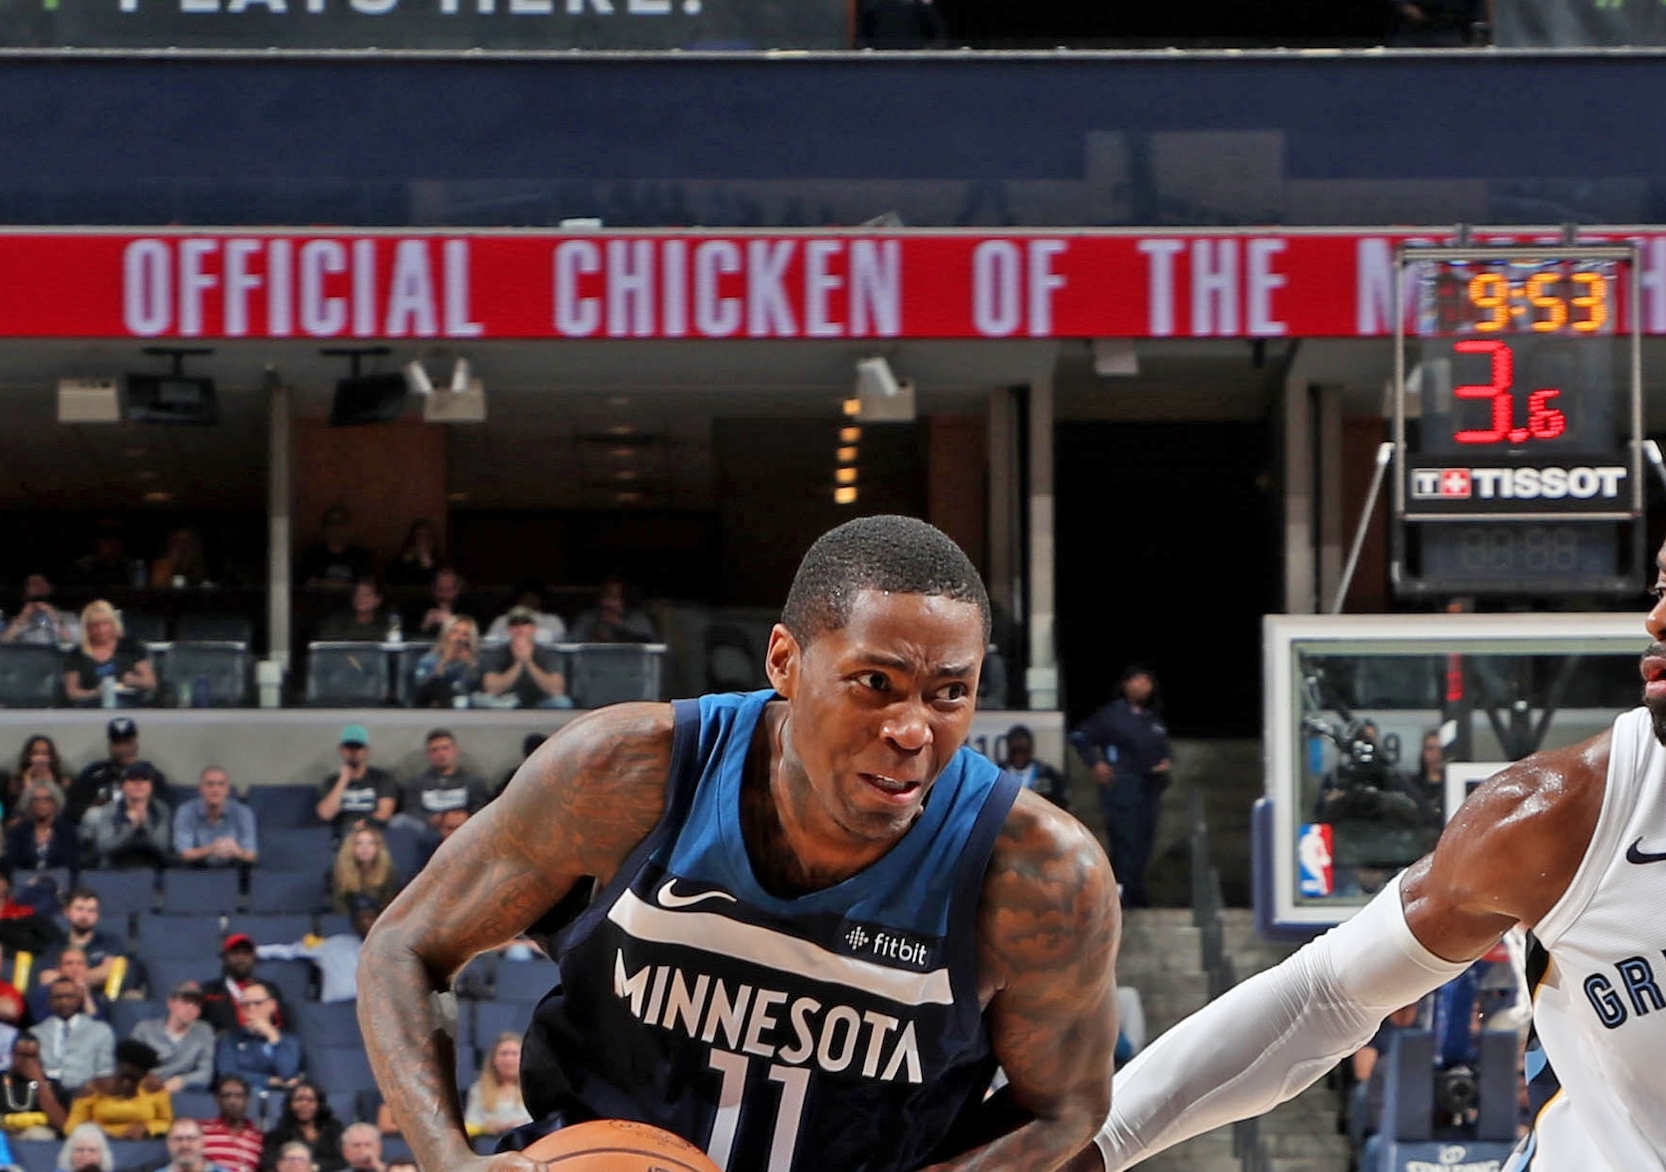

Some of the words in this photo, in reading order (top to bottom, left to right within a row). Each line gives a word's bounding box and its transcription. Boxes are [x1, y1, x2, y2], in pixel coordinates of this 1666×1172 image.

[125, 238, 483, 338] OFFICIAL
[555, 238, 901, 338] CHICKEN
[974, 238, 1067, 338] OF
[1138, 238, 1287, 337] THE
[1468, 272, 1609, 333] 9:53
[1453, 339, 1566, 443] 3.6
[1471, 467, 1628, 498] TISSOT
[873, 931, 928, 966] fitbit
[613, 948, 923, 1085] MINNESOTA
